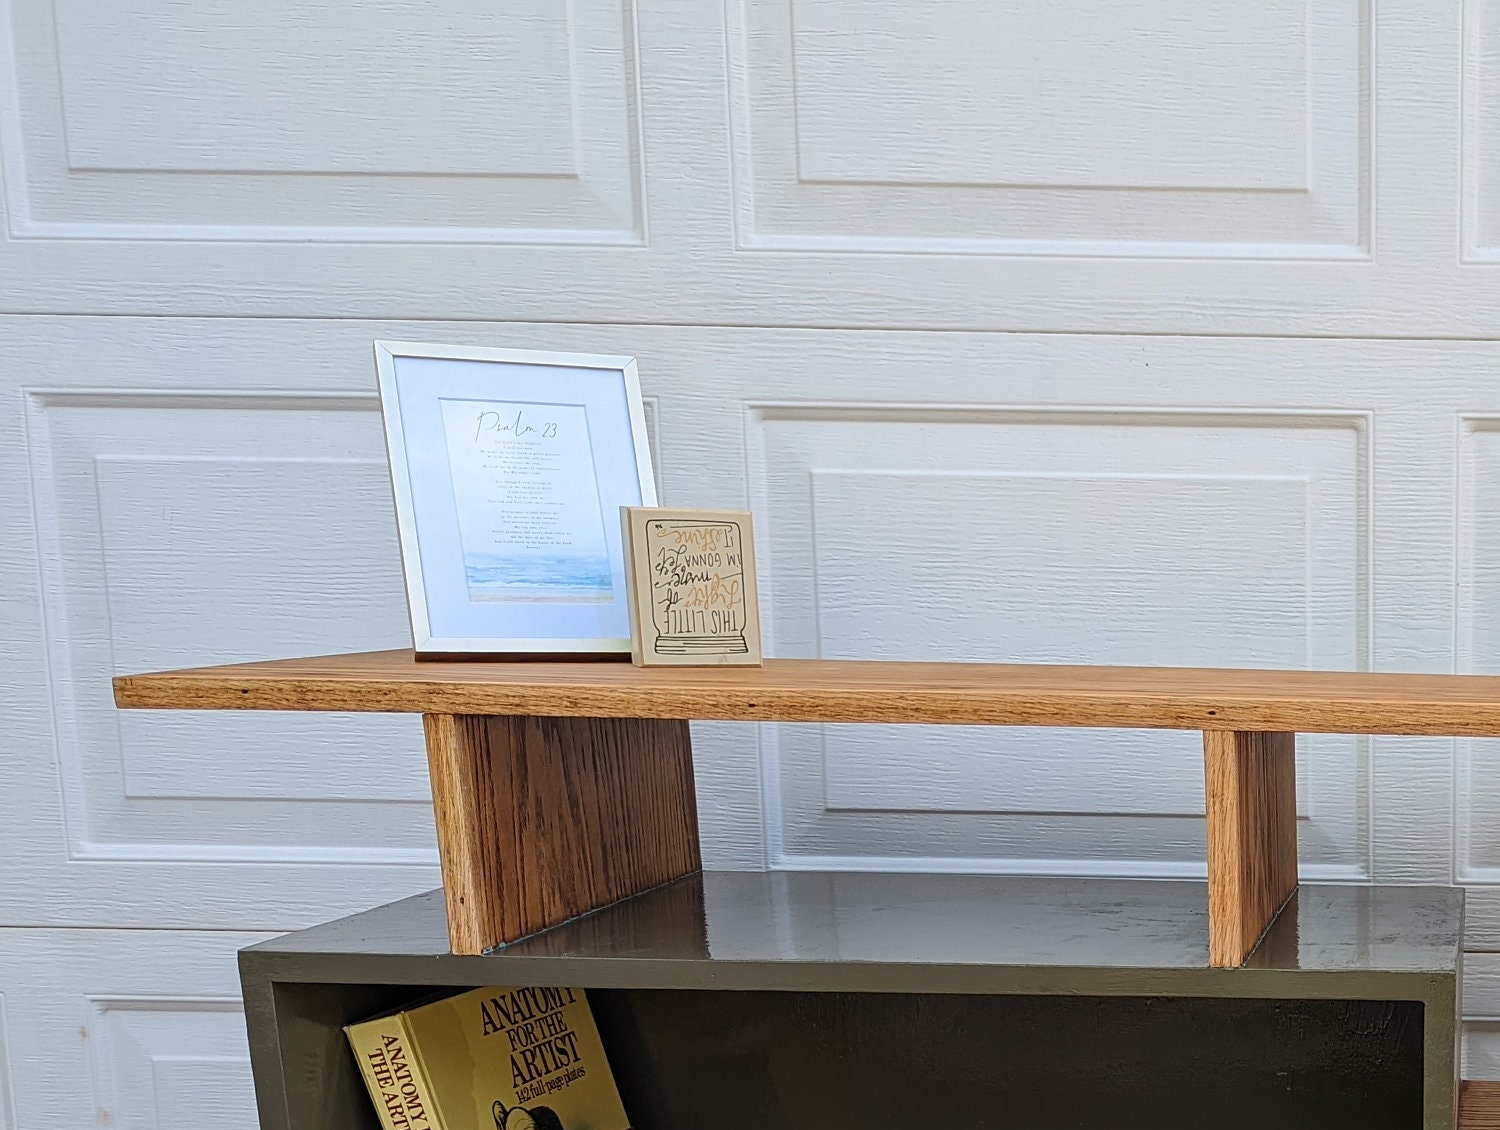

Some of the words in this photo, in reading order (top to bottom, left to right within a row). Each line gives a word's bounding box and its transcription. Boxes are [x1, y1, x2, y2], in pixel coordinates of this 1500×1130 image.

[475, 410, 537, 443] Psalm
[542, 422, 558, 438] 23
[685, 552, 722, 568] GONNA
[654, 565, 712, 589] mine
[658, 588, 684, 611] of
[664, 609, 706, 635] LITTLE
[711, 609, 738, 635] THIS
[506, 1022, 539, 1052] FOR
[535, 1011, 568, 1040] THE
[368, 1048, 396, 1089] THE
[510, 1031, 582, 1089] ARTIST
[381, 1034, 429, 1122] ANATOMY
[515, 1086, 532, 1105] 142
[563, 1066, 586, 1087] plates
